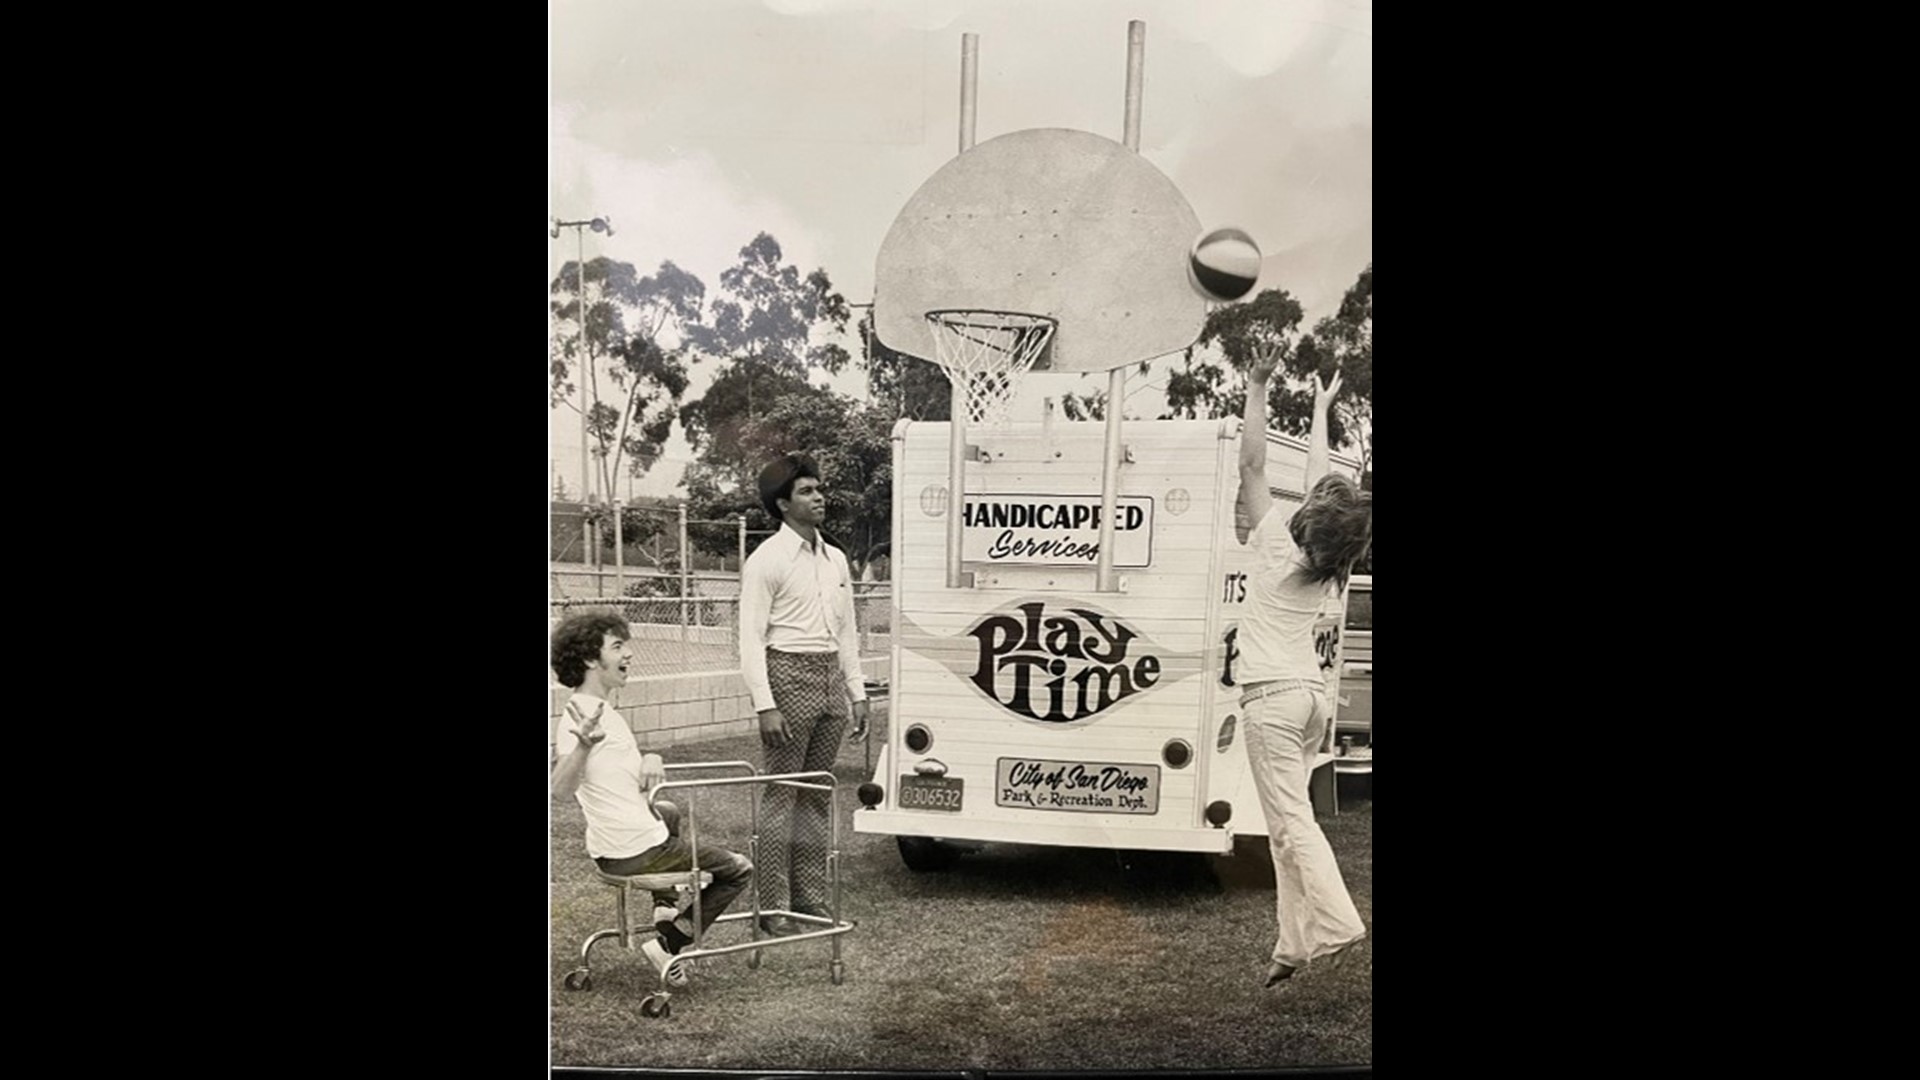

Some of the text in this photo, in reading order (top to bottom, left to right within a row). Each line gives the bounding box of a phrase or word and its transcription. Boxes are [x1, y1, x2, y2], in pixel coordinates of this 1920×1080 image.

[988, 530, 1100, 560] Services
[1223, 571, 1247, 603] IT'S
[967, 602, 1138, 701] Play
[998, 654, 1160, 722] Time
[1009, 762, 1148, 794] City of San Diego
[1003, 789, 1148, 811] Park & Recreation Dept.
